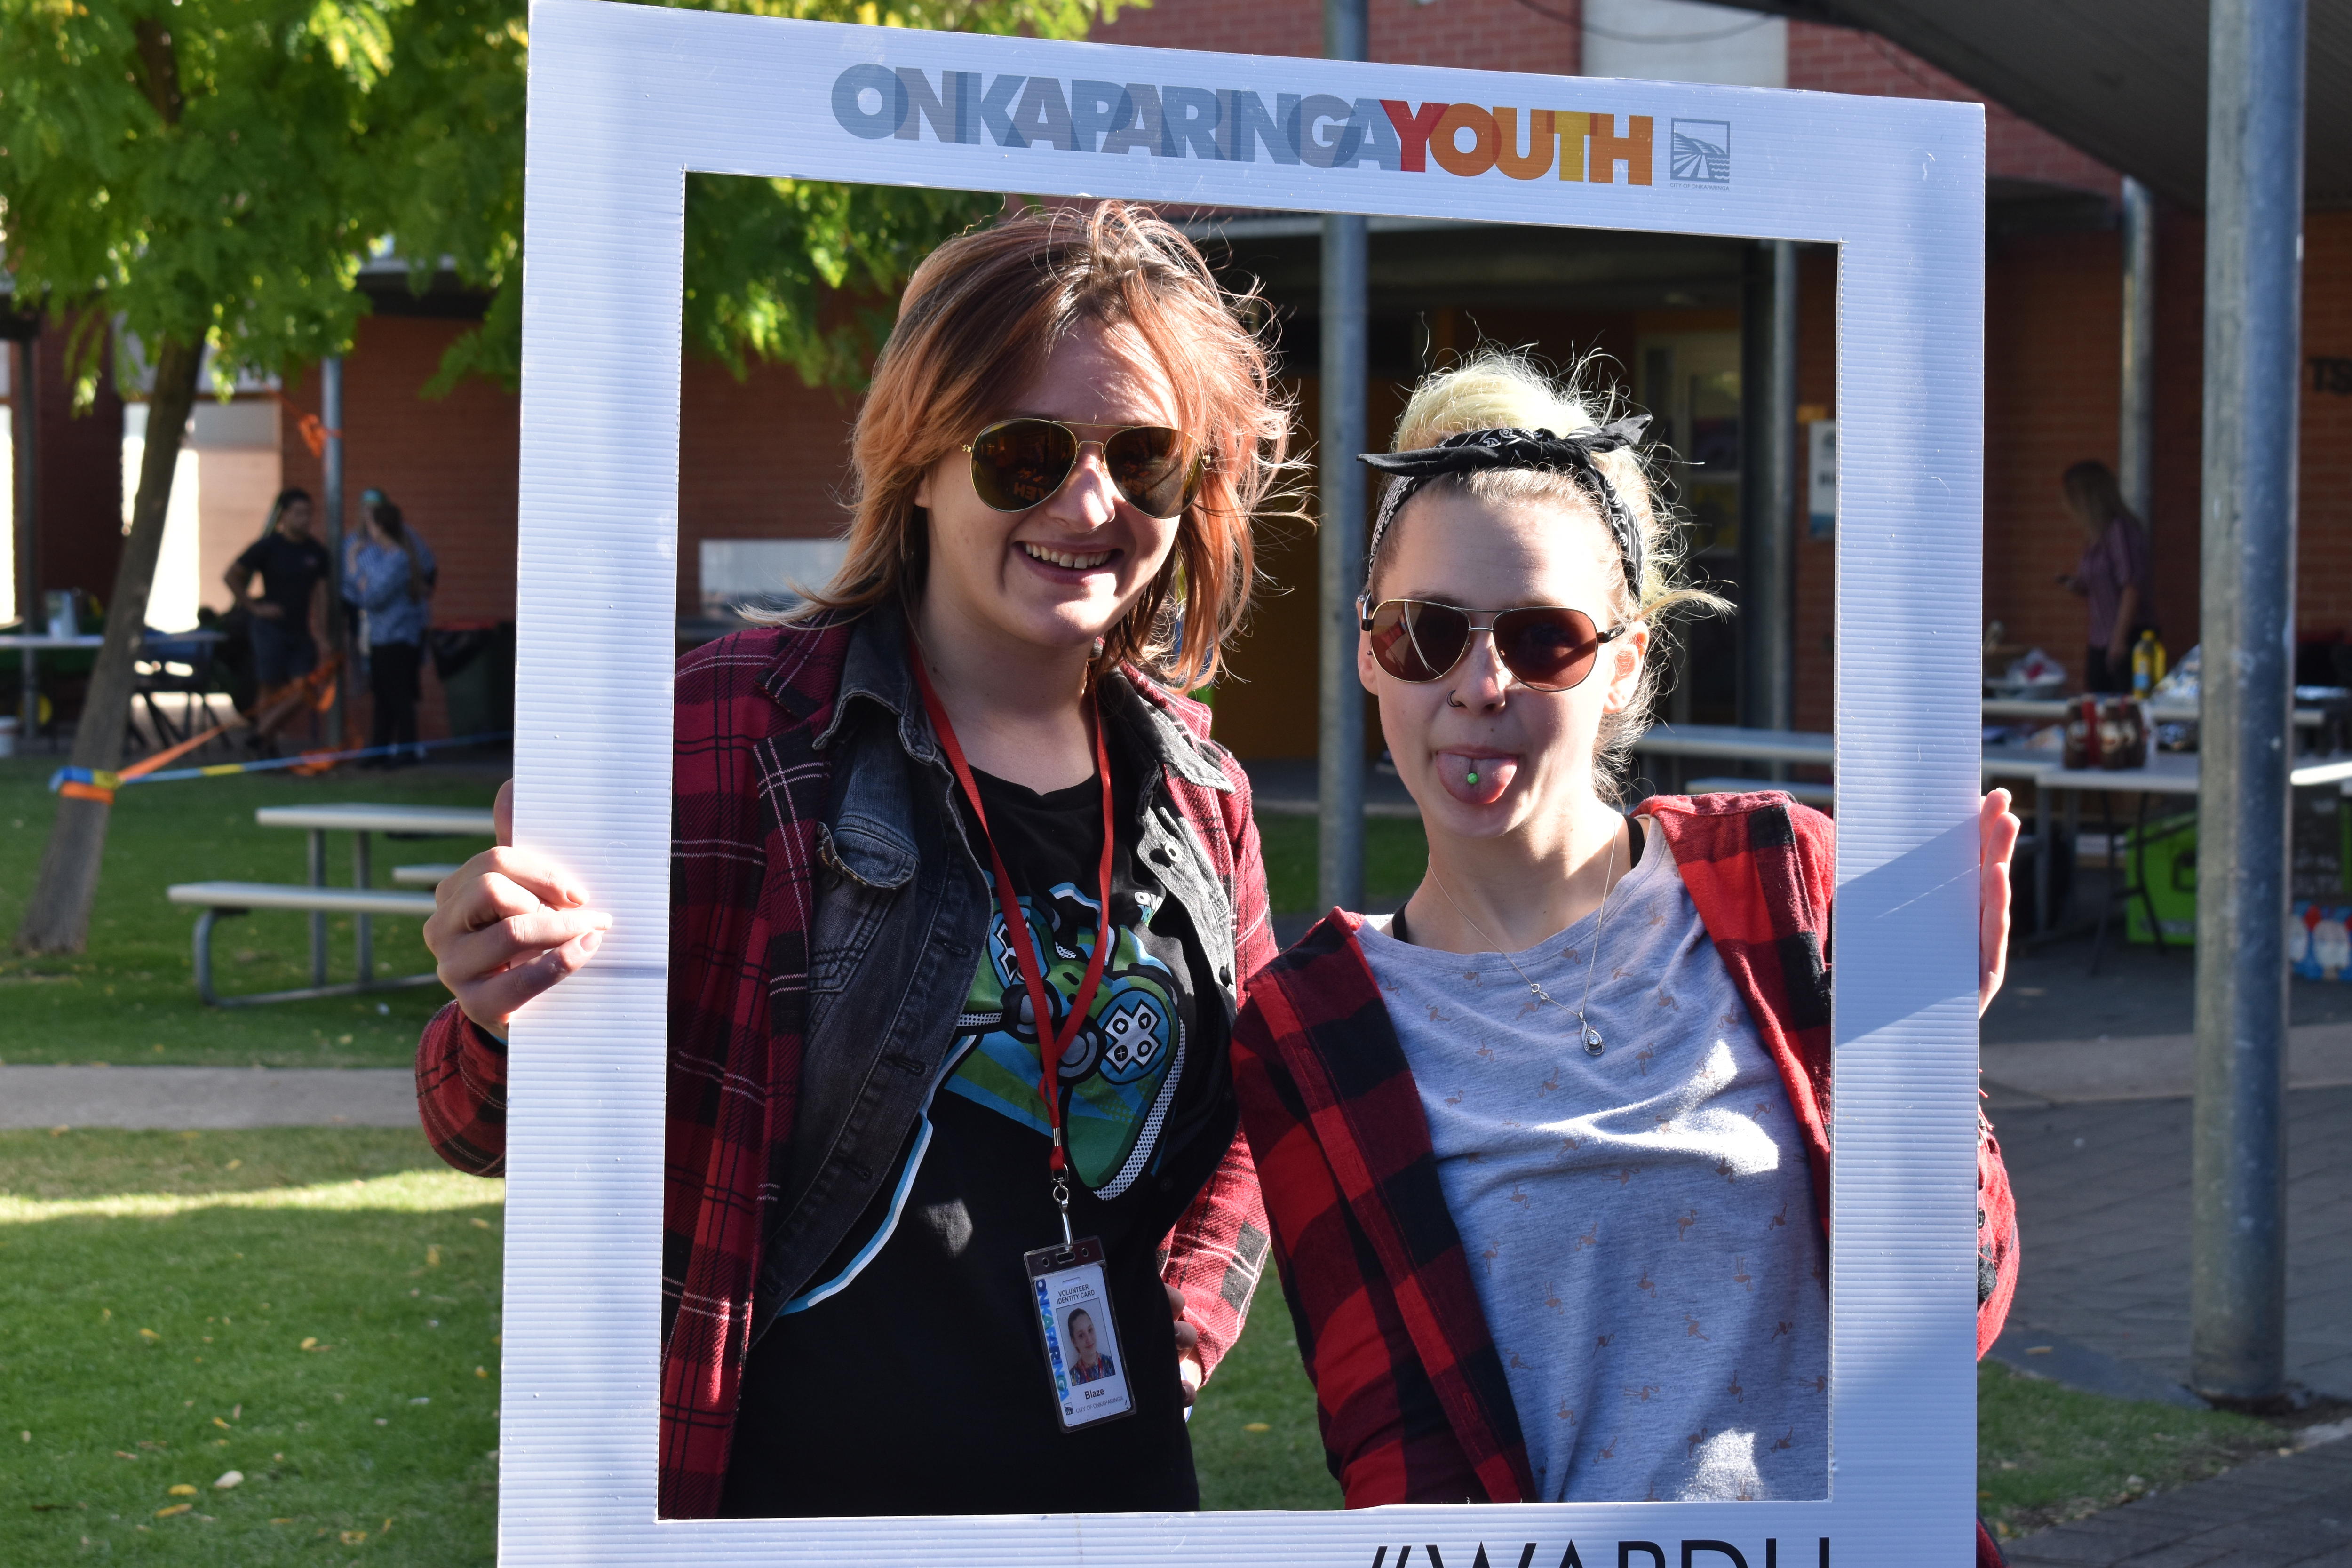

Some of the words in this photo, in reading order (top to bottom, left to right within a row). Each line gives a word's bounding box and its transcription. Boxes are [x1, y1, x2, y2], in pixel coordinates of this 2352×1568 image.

[1057, 1293, 1079, 1305] IDENTITY
[1080, 1289, 1095, 1298] CARD
[1058, 1284, 1089, 1297] VOLUNTEER
[1035, 1279, 1070, 1402] ONKAPARINGA
[1084, 1388, 1104, 1400] Blaze
[1093, 1396, 1124, 1409] ONKAPARINGA
